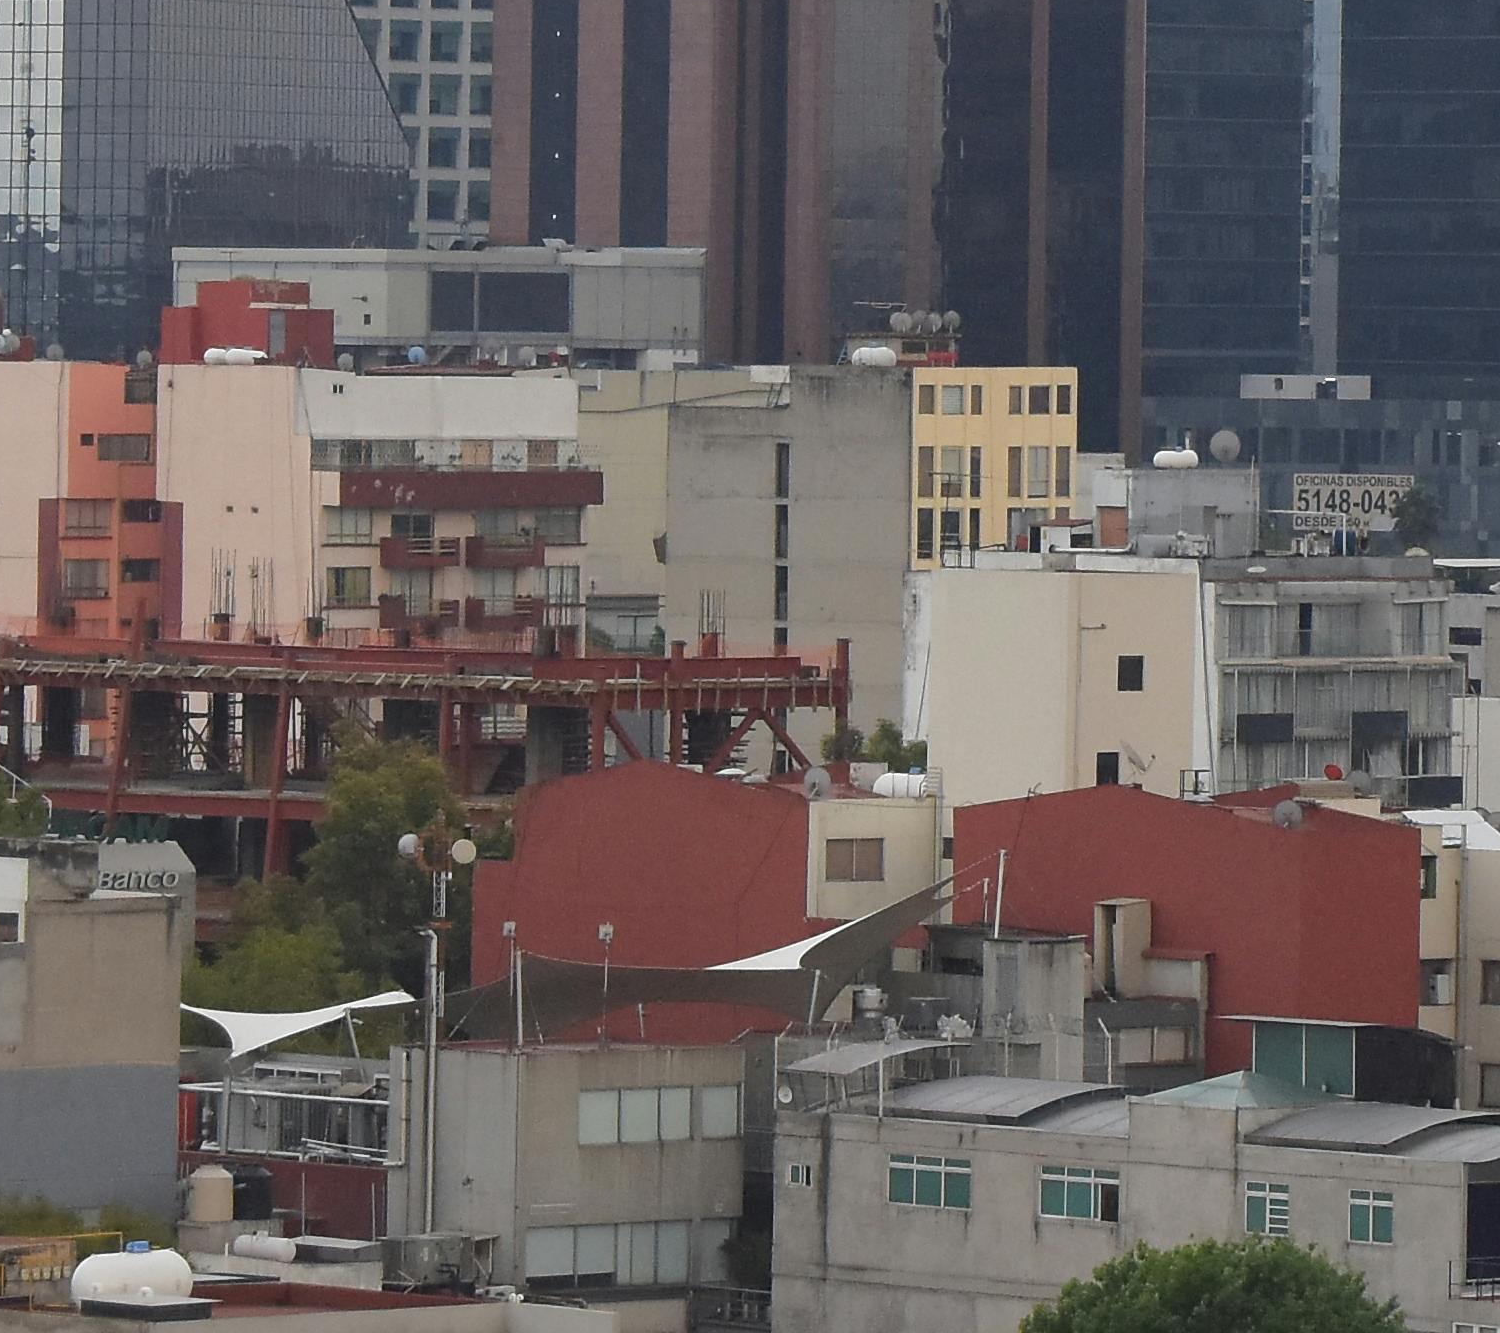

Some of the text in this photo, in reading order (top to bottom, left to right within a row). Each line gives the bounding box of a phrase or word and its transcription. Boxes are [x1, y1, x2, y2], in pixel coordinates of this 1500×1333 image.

[1296, 475, 1412, 488] OFICINAS DISPONIBLES
[1295, 516, 1336, 527] DESDE
[99, 871, 179, 890] Banco
